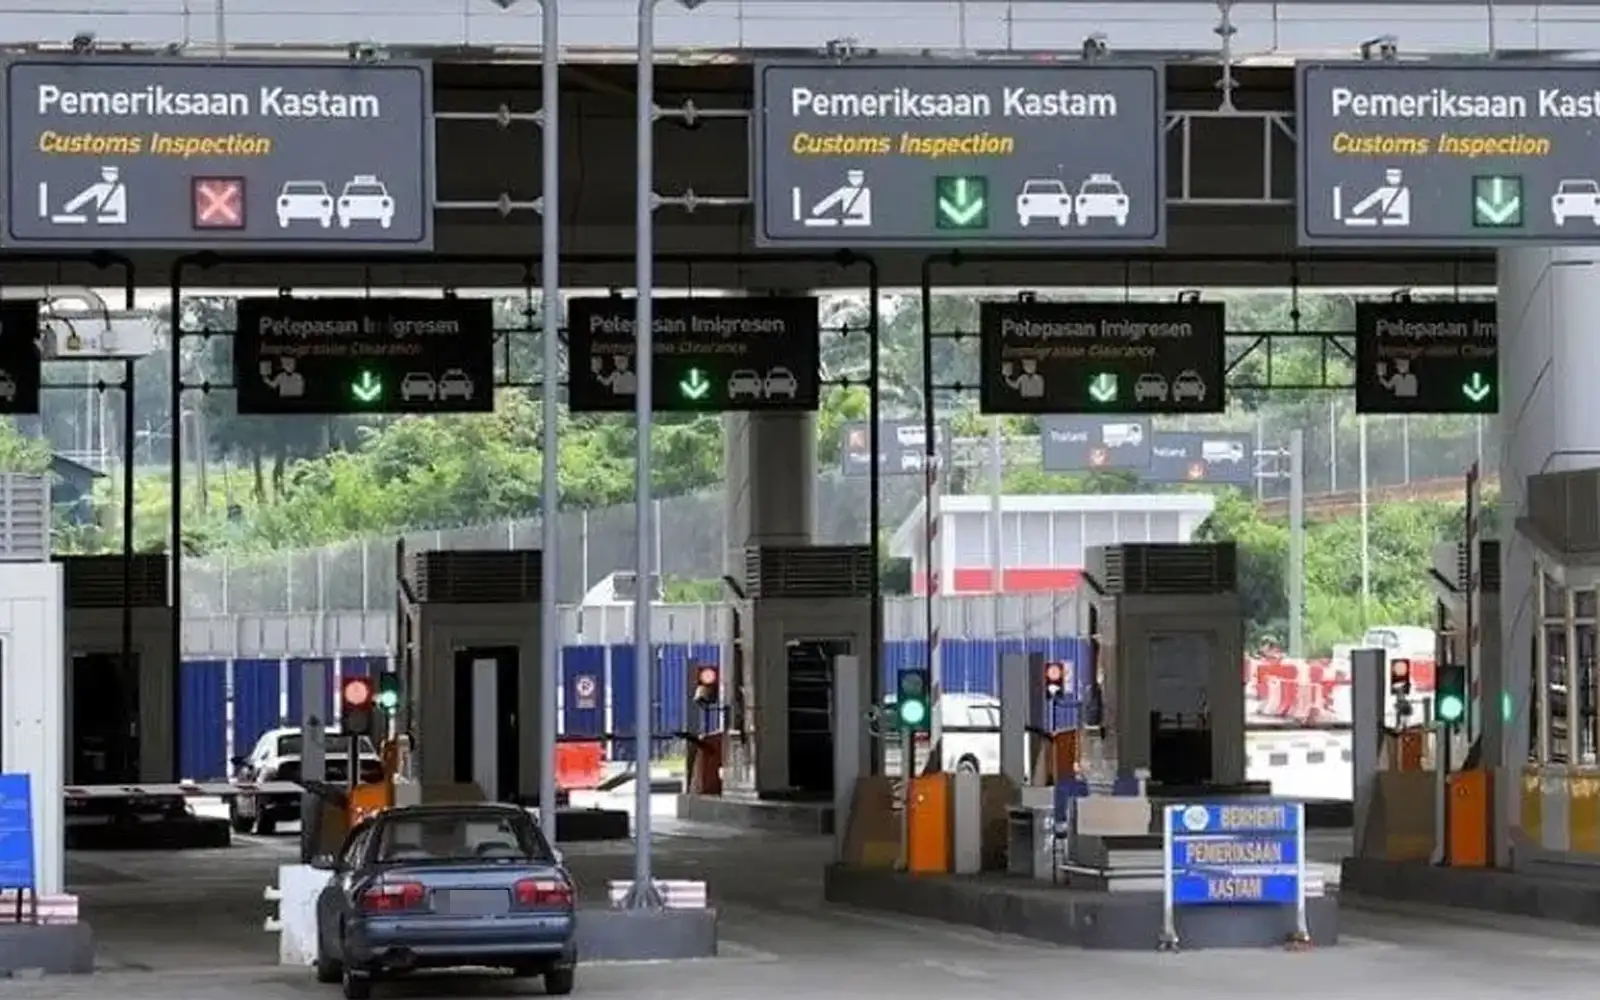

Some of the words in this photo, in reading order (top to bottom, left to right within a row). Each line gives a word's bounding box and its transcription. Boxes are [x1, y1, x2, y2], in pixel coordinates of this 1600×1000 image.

[38, 85, 249, 116] Pemeriksaan
[260, 87, 380, 117] Kastam
[792, 88, 990, 117] Pemeriksaan
[1003, 88, 1117, 117] Kastam
[1331, 88, 1526, 117] Pemeriksaan
[39, 130, 141, 154] Customs
[150, 132, 271, 159] Inspection
[792, 131, 890, 155] Customs
[900, 132, 1014, 159] Inspection
[1332, 131, 1429, 154] Customs
[1437, 132, 1551, 158] Inspection
[1186, 841, 1282, 863] PEMERIKSAAN
[1207, 877, 1262, 900] KASTAM
